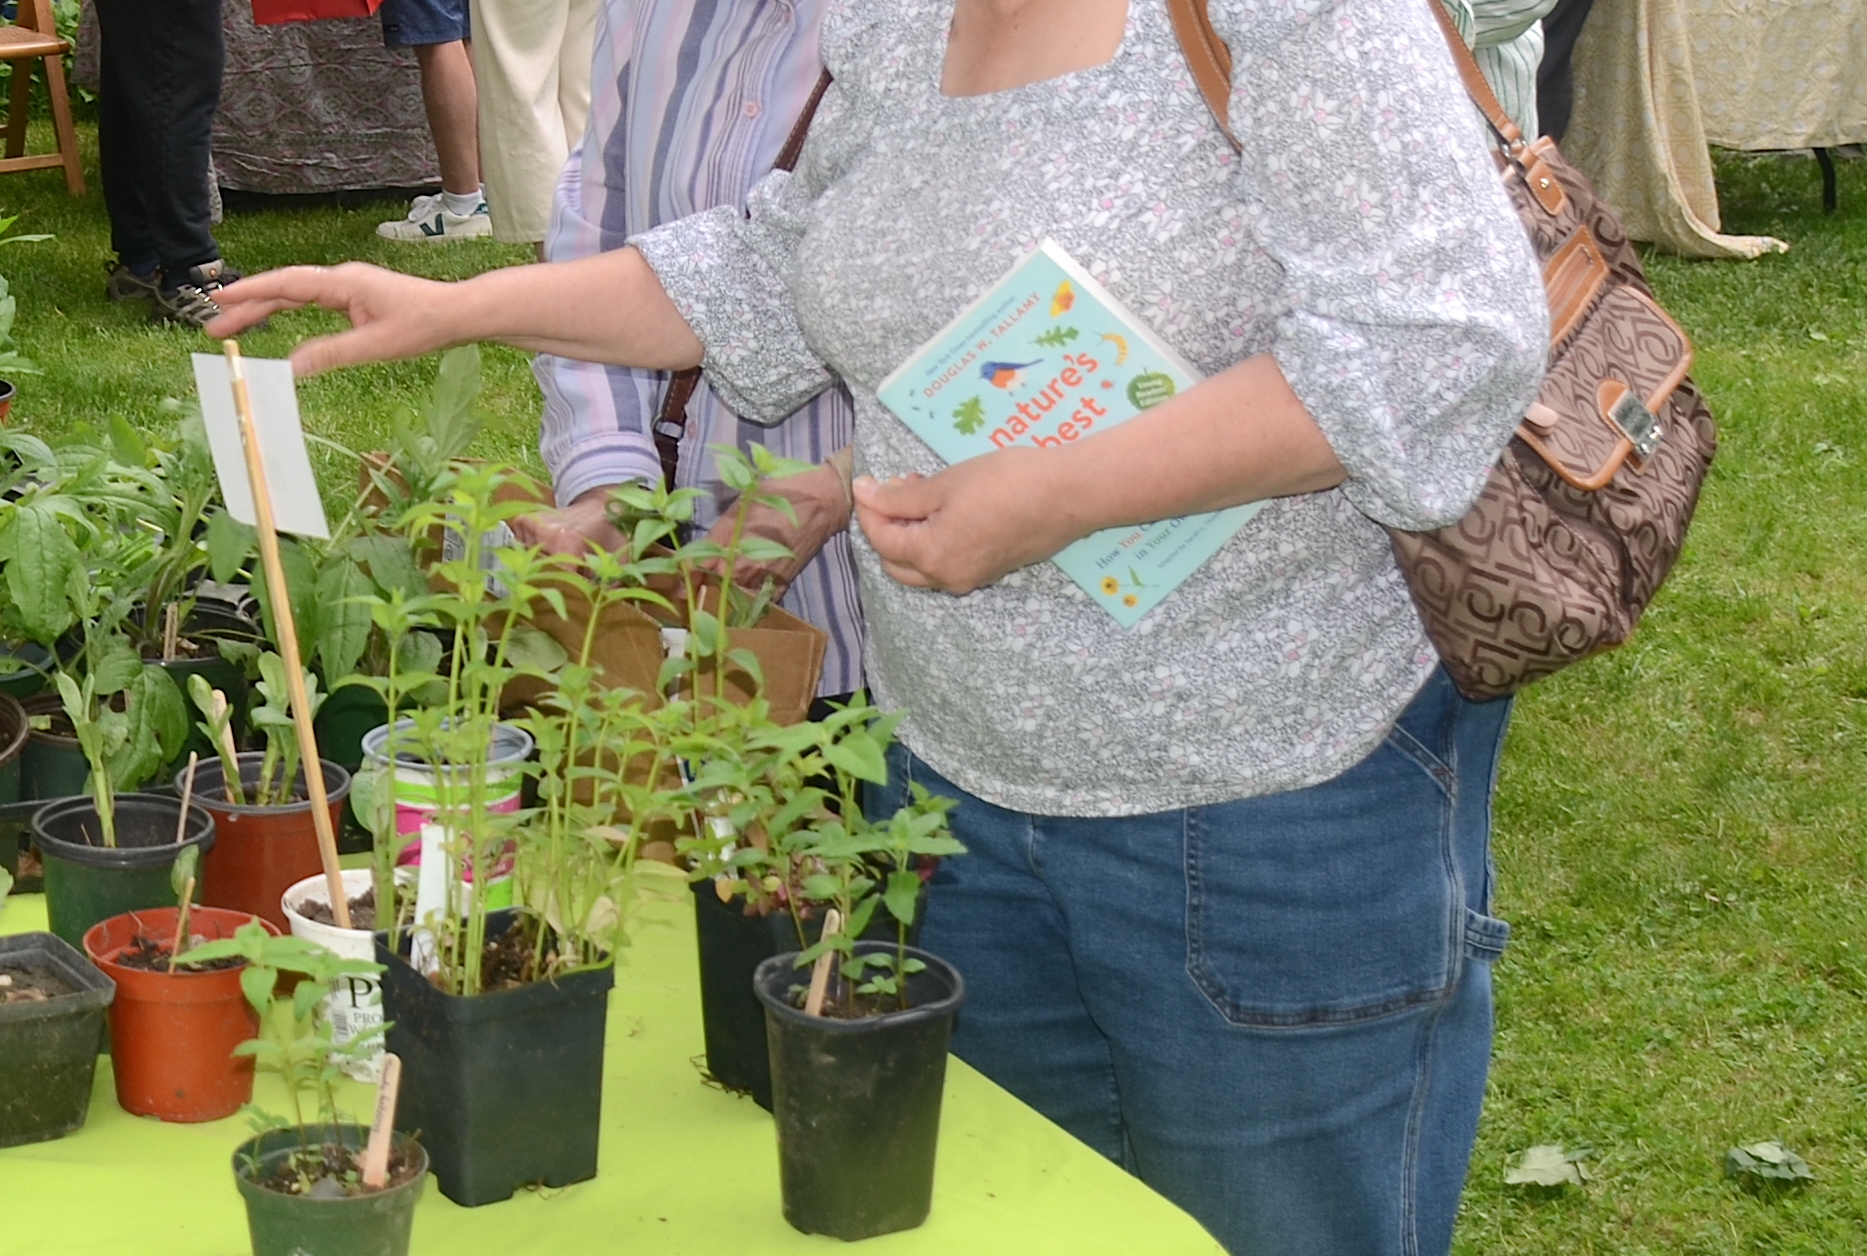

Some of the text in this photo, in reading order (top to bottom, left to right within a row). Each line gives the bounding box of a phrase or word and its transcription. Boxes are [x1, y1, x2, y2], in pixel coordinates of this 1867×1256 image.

[923, 291, 1041, 398] DOUGLAS W. TALLAMY
[988, 352, 1099, 449] nature's
[1095, 531, 1142, 569] How You
[1134, 548, 1148, 560] in
[1145, 528, 1172, 549] Your
[353, 1012, 384, 1024] PRO
